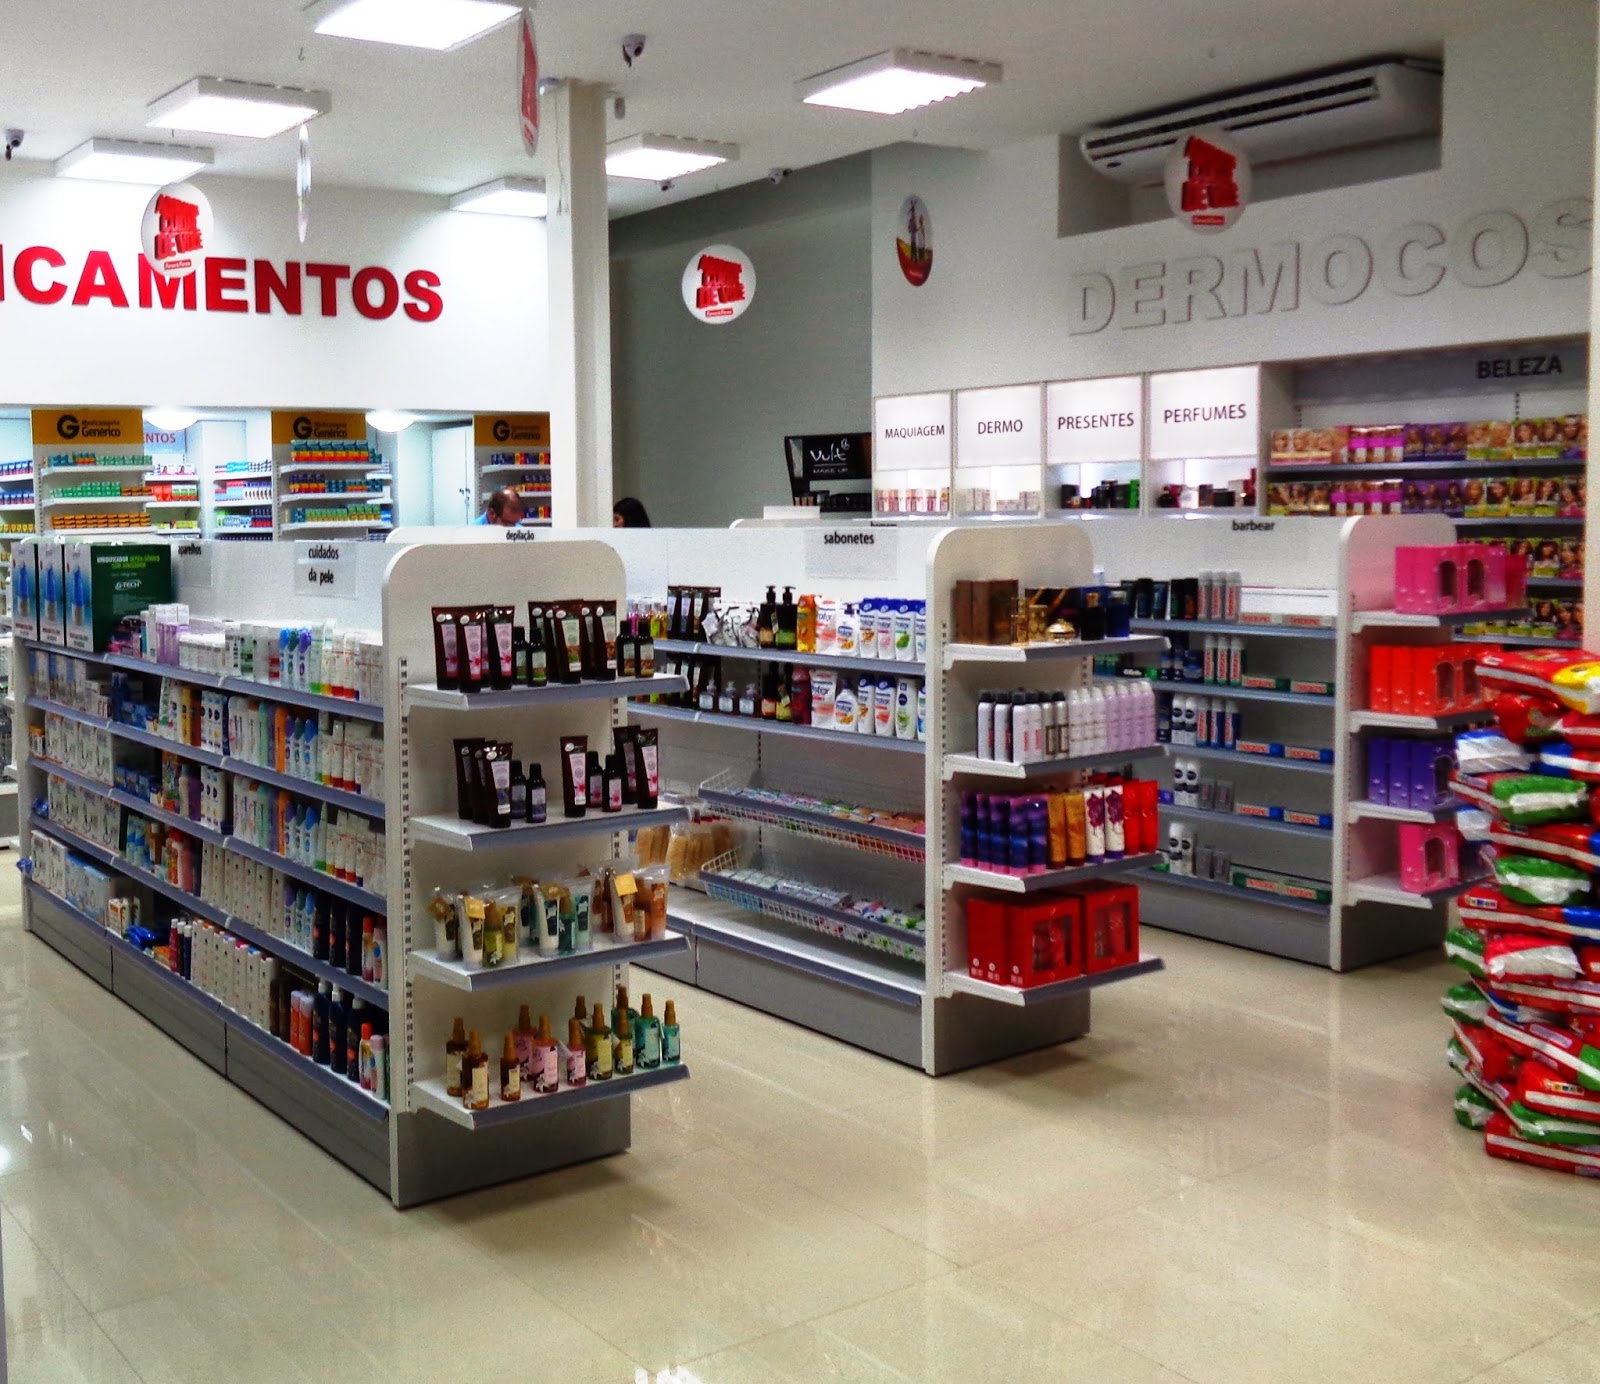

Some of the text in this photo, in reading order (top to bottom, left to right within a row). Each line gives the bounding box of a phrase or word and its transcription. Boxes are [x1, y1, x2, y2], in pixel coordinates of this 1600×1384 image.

[1477, 354, 1562, 379] BELEZA
[1057, 412, 1134, 430] PRESENTES
[1164, 403, 1246, 424] PERFUMES
[57, 414, 80, 439] G
[293, 416, 313, 439] G
[493, 420, 510, 441] G
[885, 424, 945, 439] MAQUIAGEM
[977, 419, 1023, 434] DERMO
[143, 433, 176, 443] NTOS
[810, 443, 847, 461] Vult
[1232, 520, 1275, 531] barbear
[506, 529, 535, 541] depilação
[824, 531, 874, 545] sabonetes
[308, 545, 339, 559] cuidados
[308, 568, 334, 586] da pele
